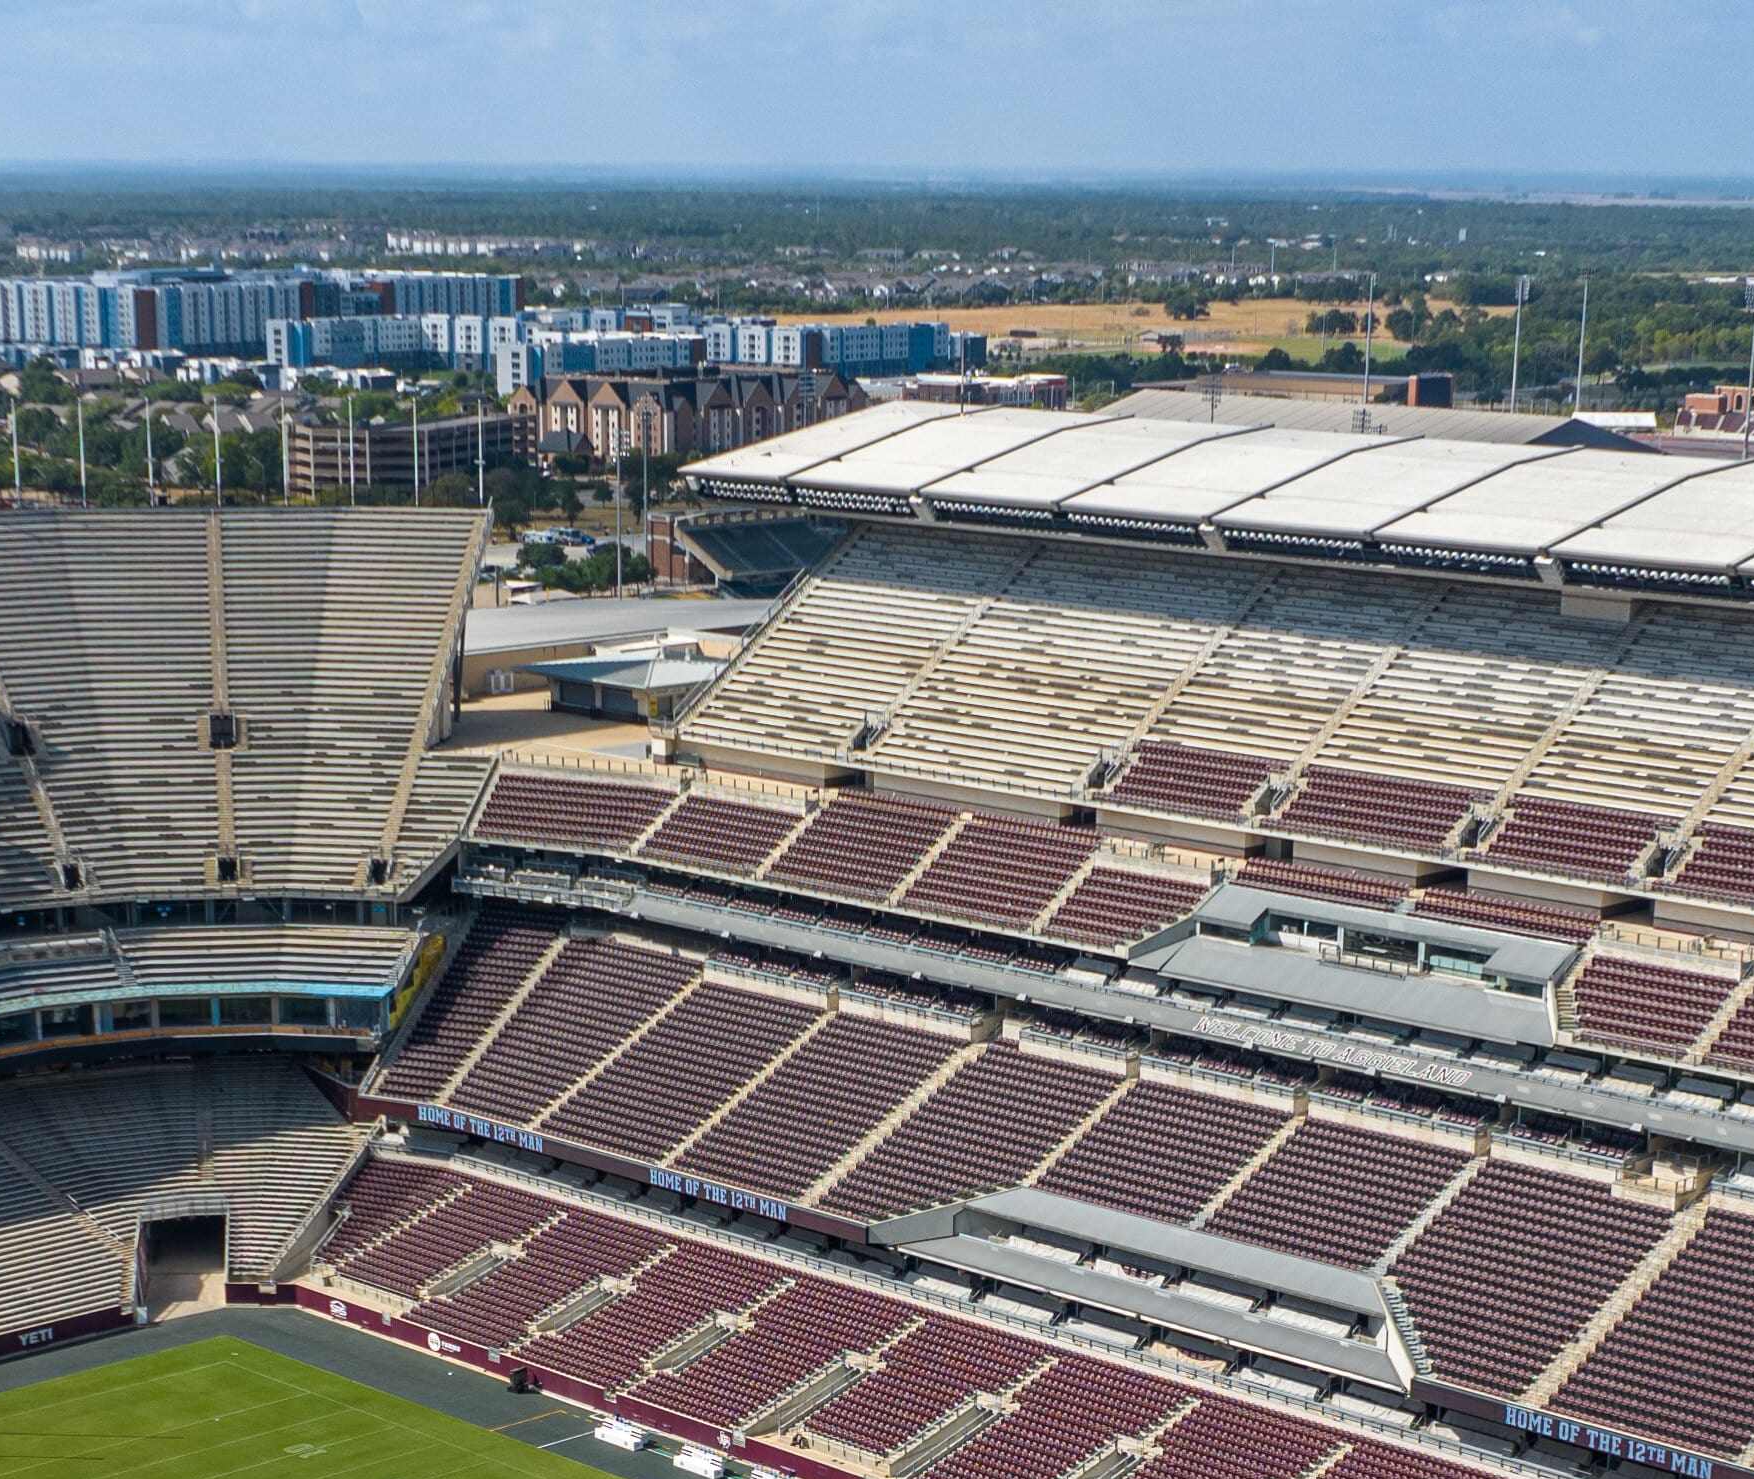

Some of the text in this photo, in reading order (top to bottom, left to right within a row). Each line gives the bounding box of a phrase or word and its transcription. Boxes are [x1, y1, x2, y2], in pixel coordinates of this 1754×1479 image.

[1192, 1016, 1473, 1086] WELCOME TO AGGIELAND
[417, 1105, 543, 1153] HOME OF THE 12TH MAN
[650, 1169, 787, 1221] HOME OF THE 12TH MAN
[18, 1327, 54, 1346] YETI
[1505, 1406, 1553, 1437] HOME
[1558, 1421, 1581, 1443] OF
[1586, 1428, 1621, 1456] THE
[1627, 1440, 1666, 1464] 12TH
